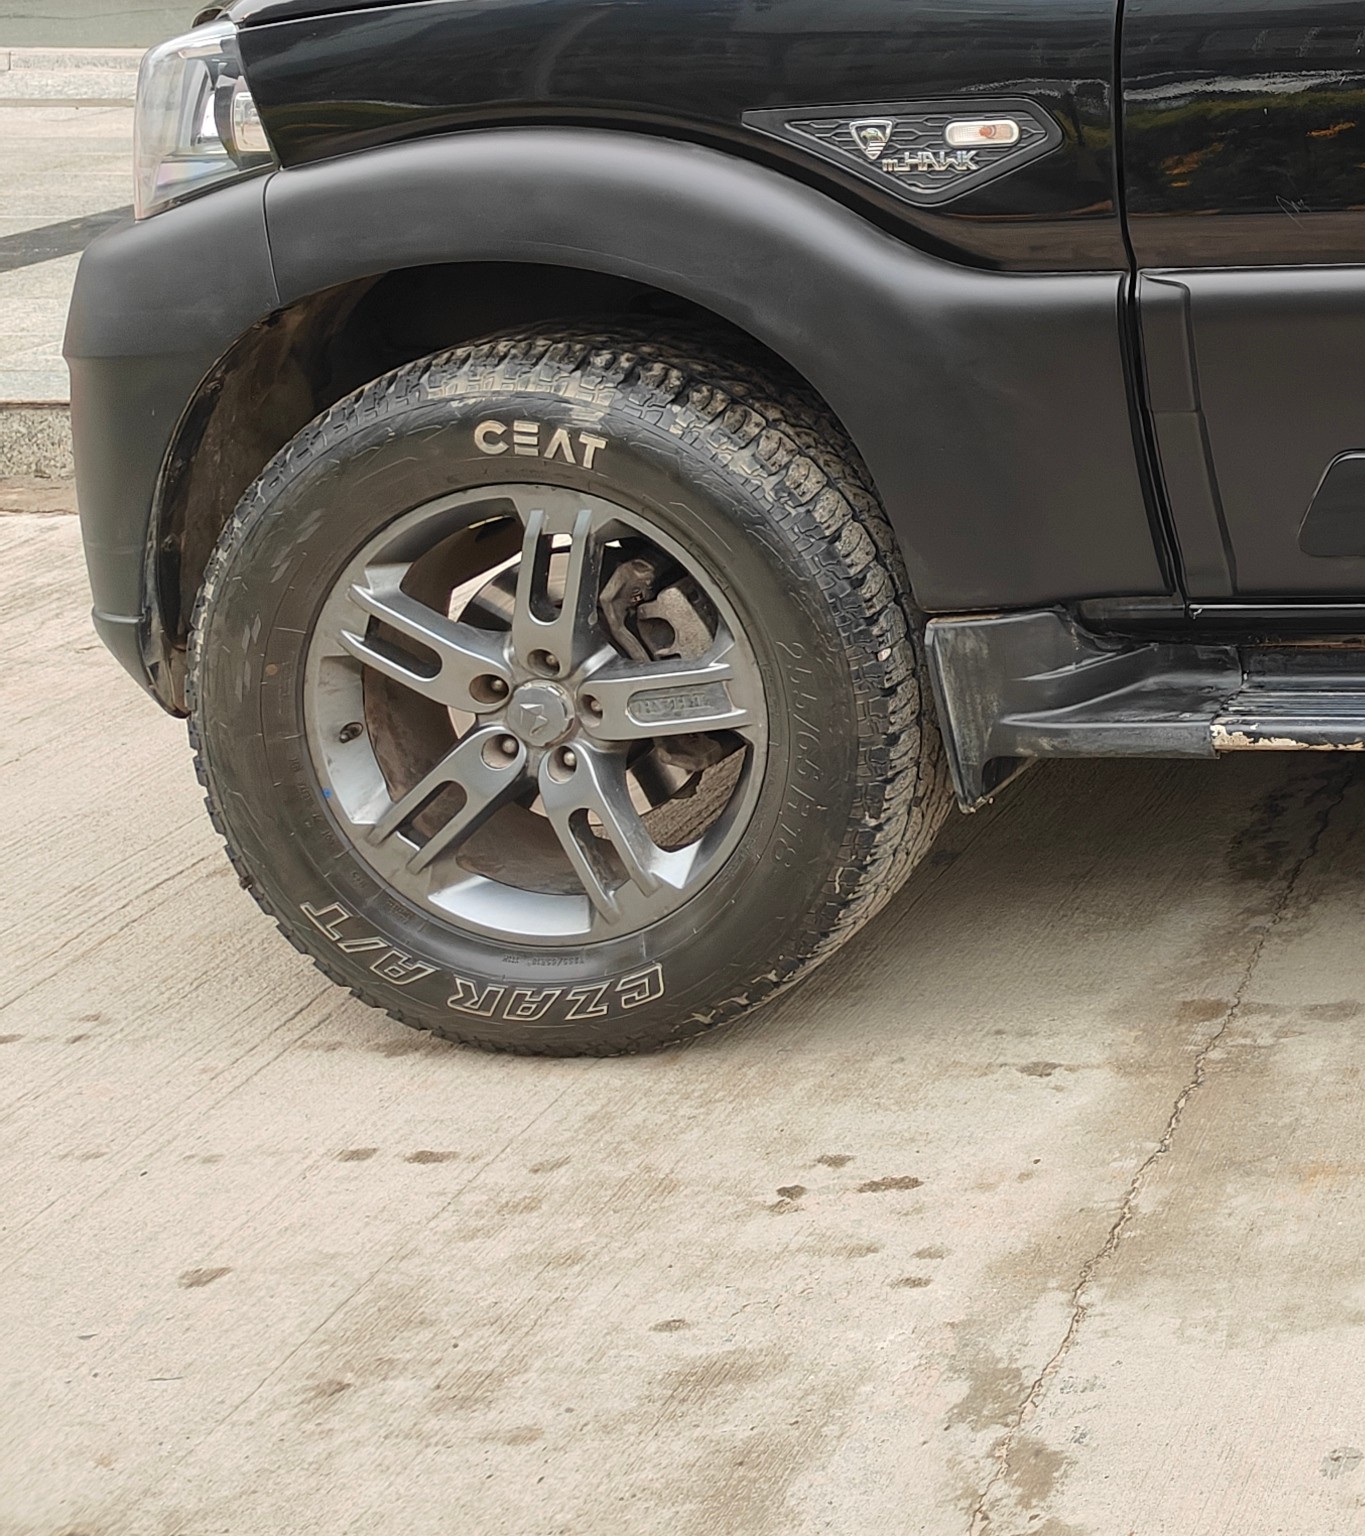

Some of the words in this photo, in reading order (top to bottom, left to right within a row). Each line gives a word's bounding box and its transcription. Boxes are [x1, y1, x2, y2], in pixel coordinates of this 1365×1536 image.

[474, 419, 609, 470] CEAT
[299, 901, 443, 986] A/T
[446, 961, 665, 1022] CZAR
